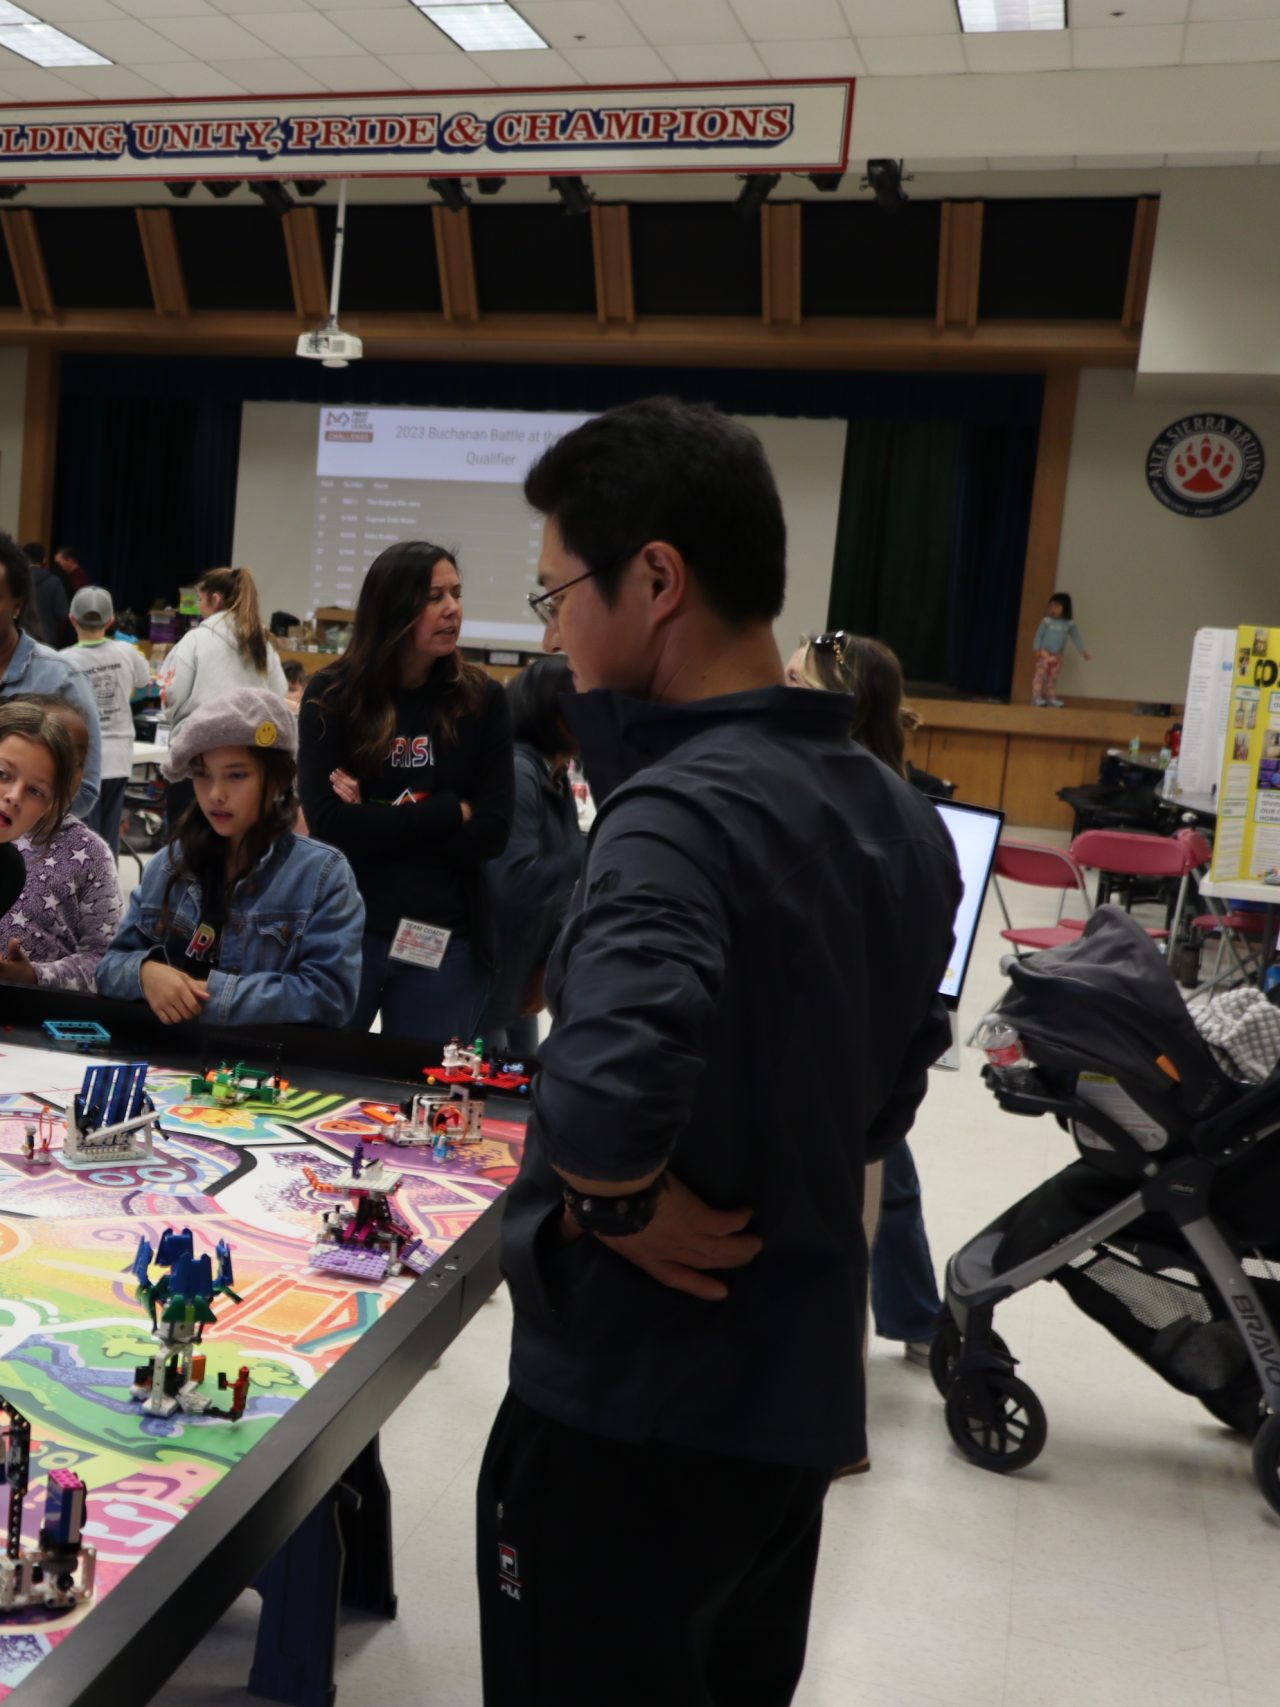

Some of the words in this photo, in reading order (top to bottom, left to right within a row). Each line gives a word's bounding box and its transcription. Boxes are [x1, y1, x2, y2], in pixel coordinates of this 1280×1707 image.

[131, 117, 285, 158] UNITY,
[290, 112, 439, 152] PRIDE
[442, 111, 487, 151] &
[490, 104, 794, 149] CHAMPIONS
[395, 425, 426, 440] 2023
[428, 427, 488, 441] Buchanan
[490, 428, 525, 442] Battle
[527, 431, 540, 443] at
[466, 451, 516, 466] Qualifier
[1149, 444, 1169, 478] ALTA
[1166, 417, 1227, 442] SIERRA
[1230, 424, 1261, 482] BRUINS
[1231, 1295, 1280, 1387] BRAVO
